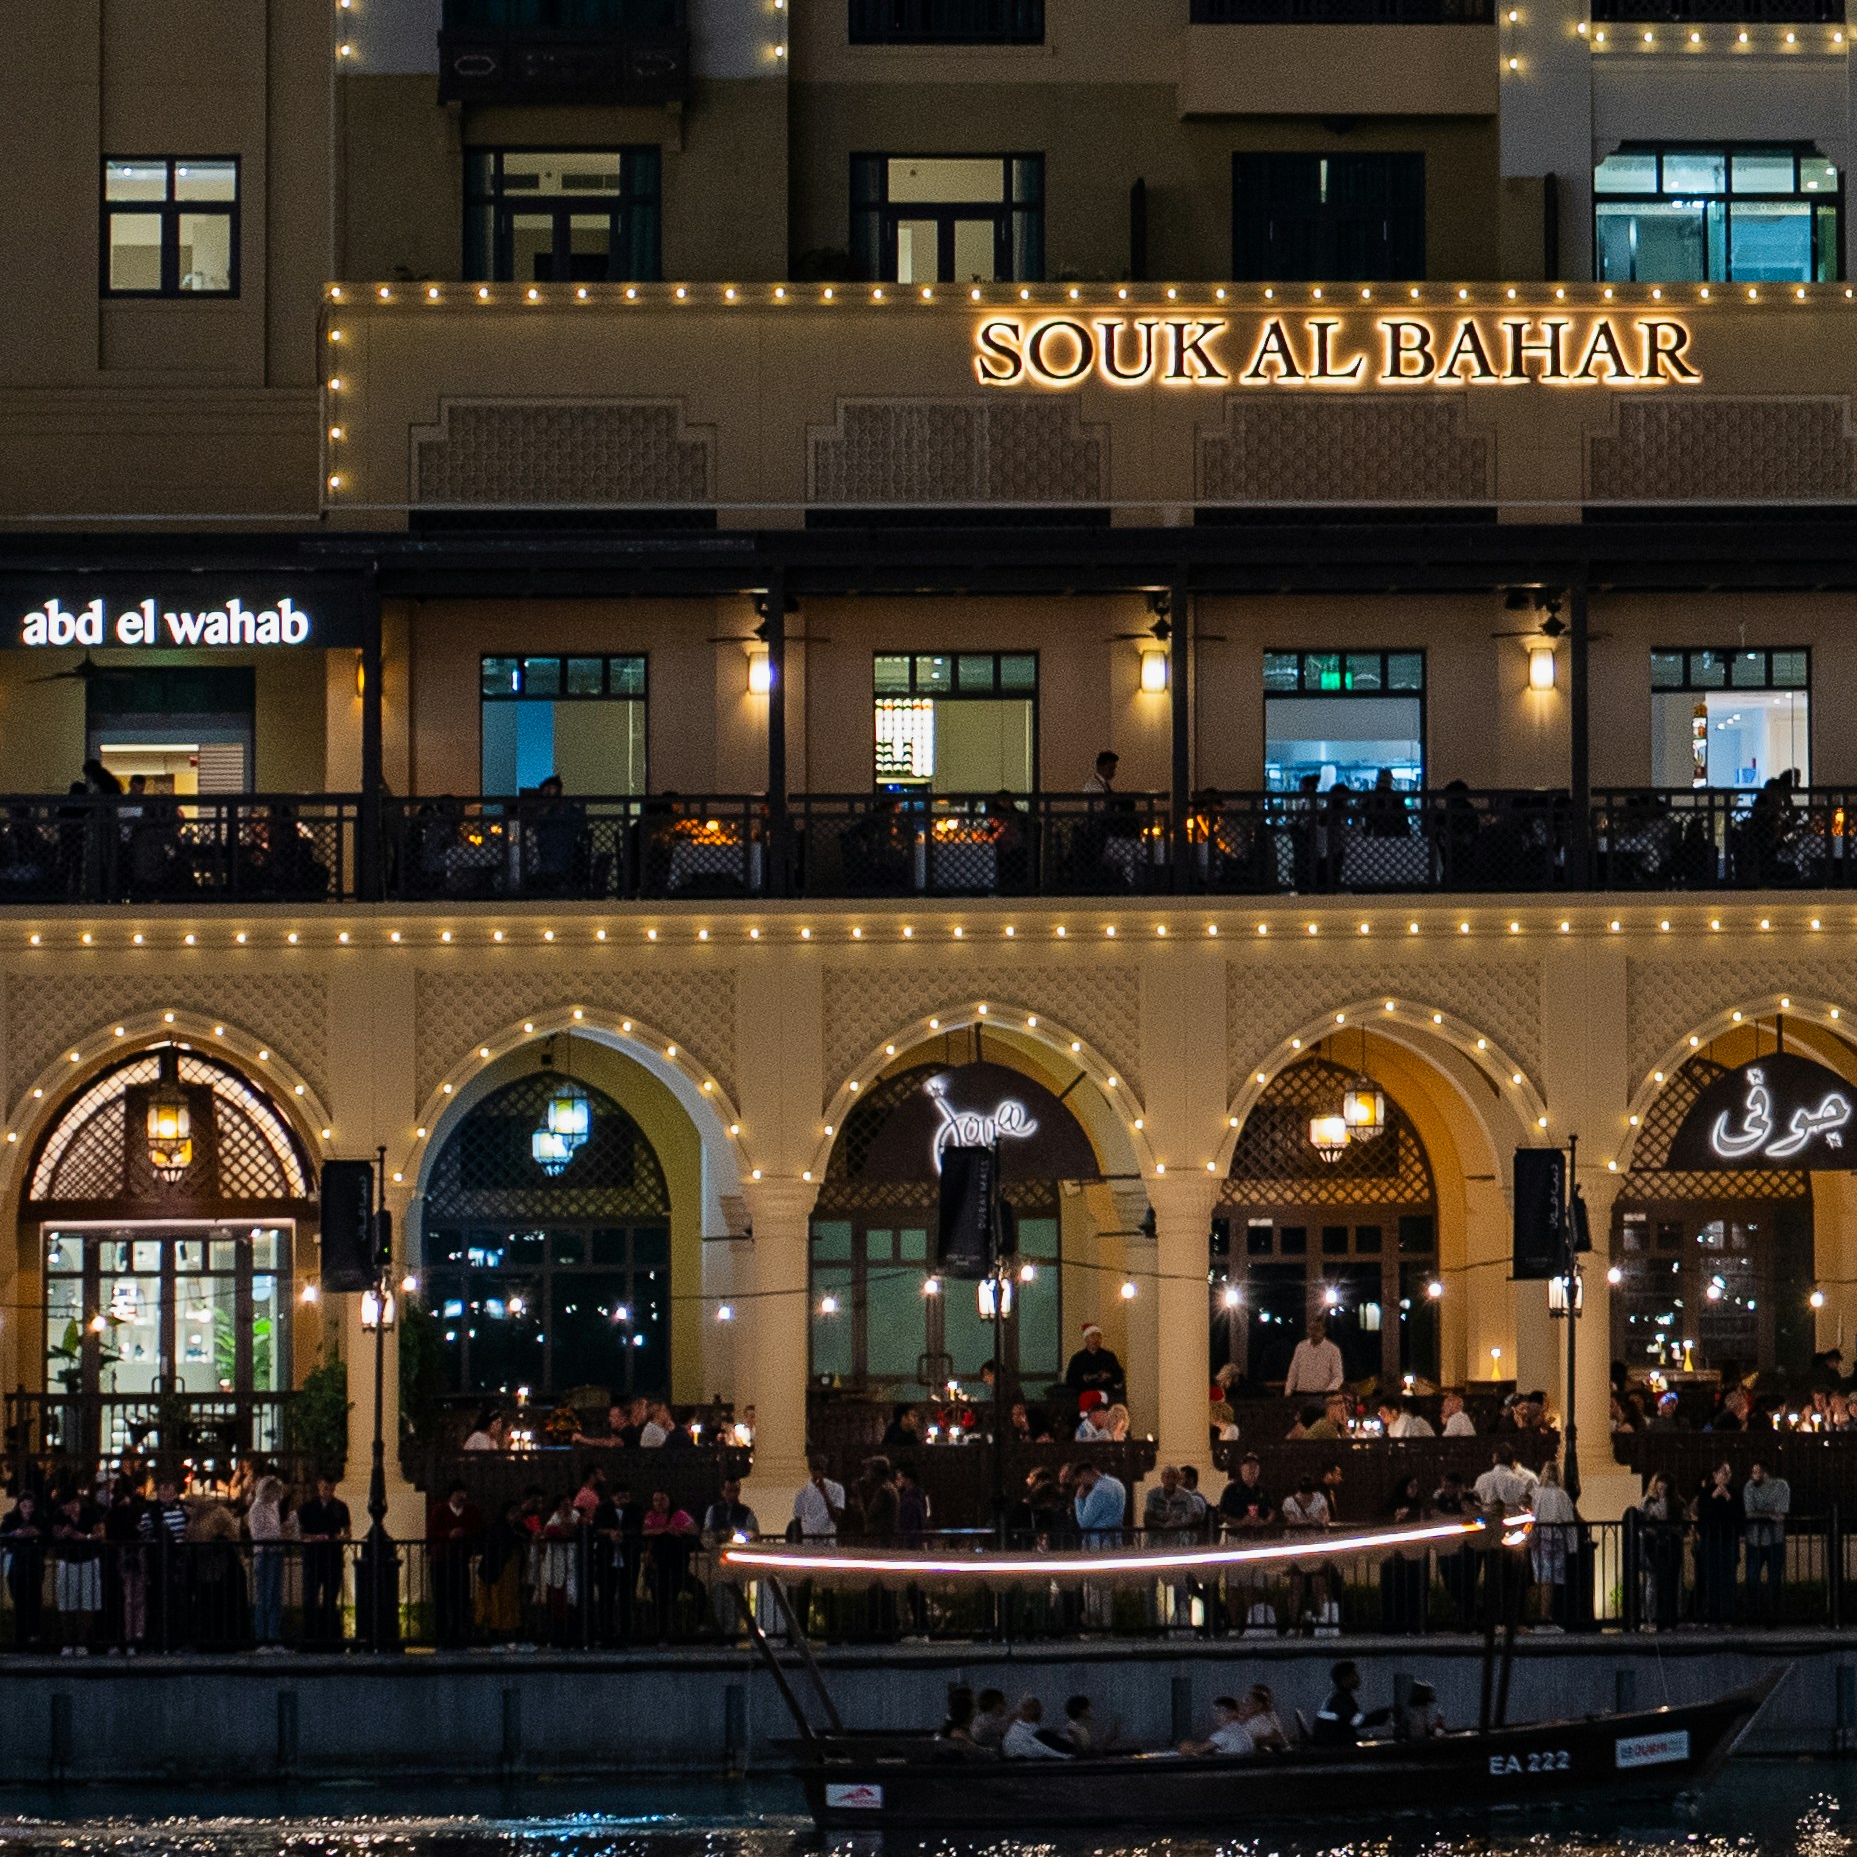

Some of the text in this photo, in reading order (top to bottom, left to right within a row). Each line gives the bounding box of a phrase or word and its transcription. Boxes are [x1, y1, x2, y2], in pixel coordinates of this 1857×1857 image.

[976, 317, 1702, 387] SOUK AL BAHAR
[23, 598, 310, 645] abd el wahab
[1489, 1750, 1570, 1775] EA 222
